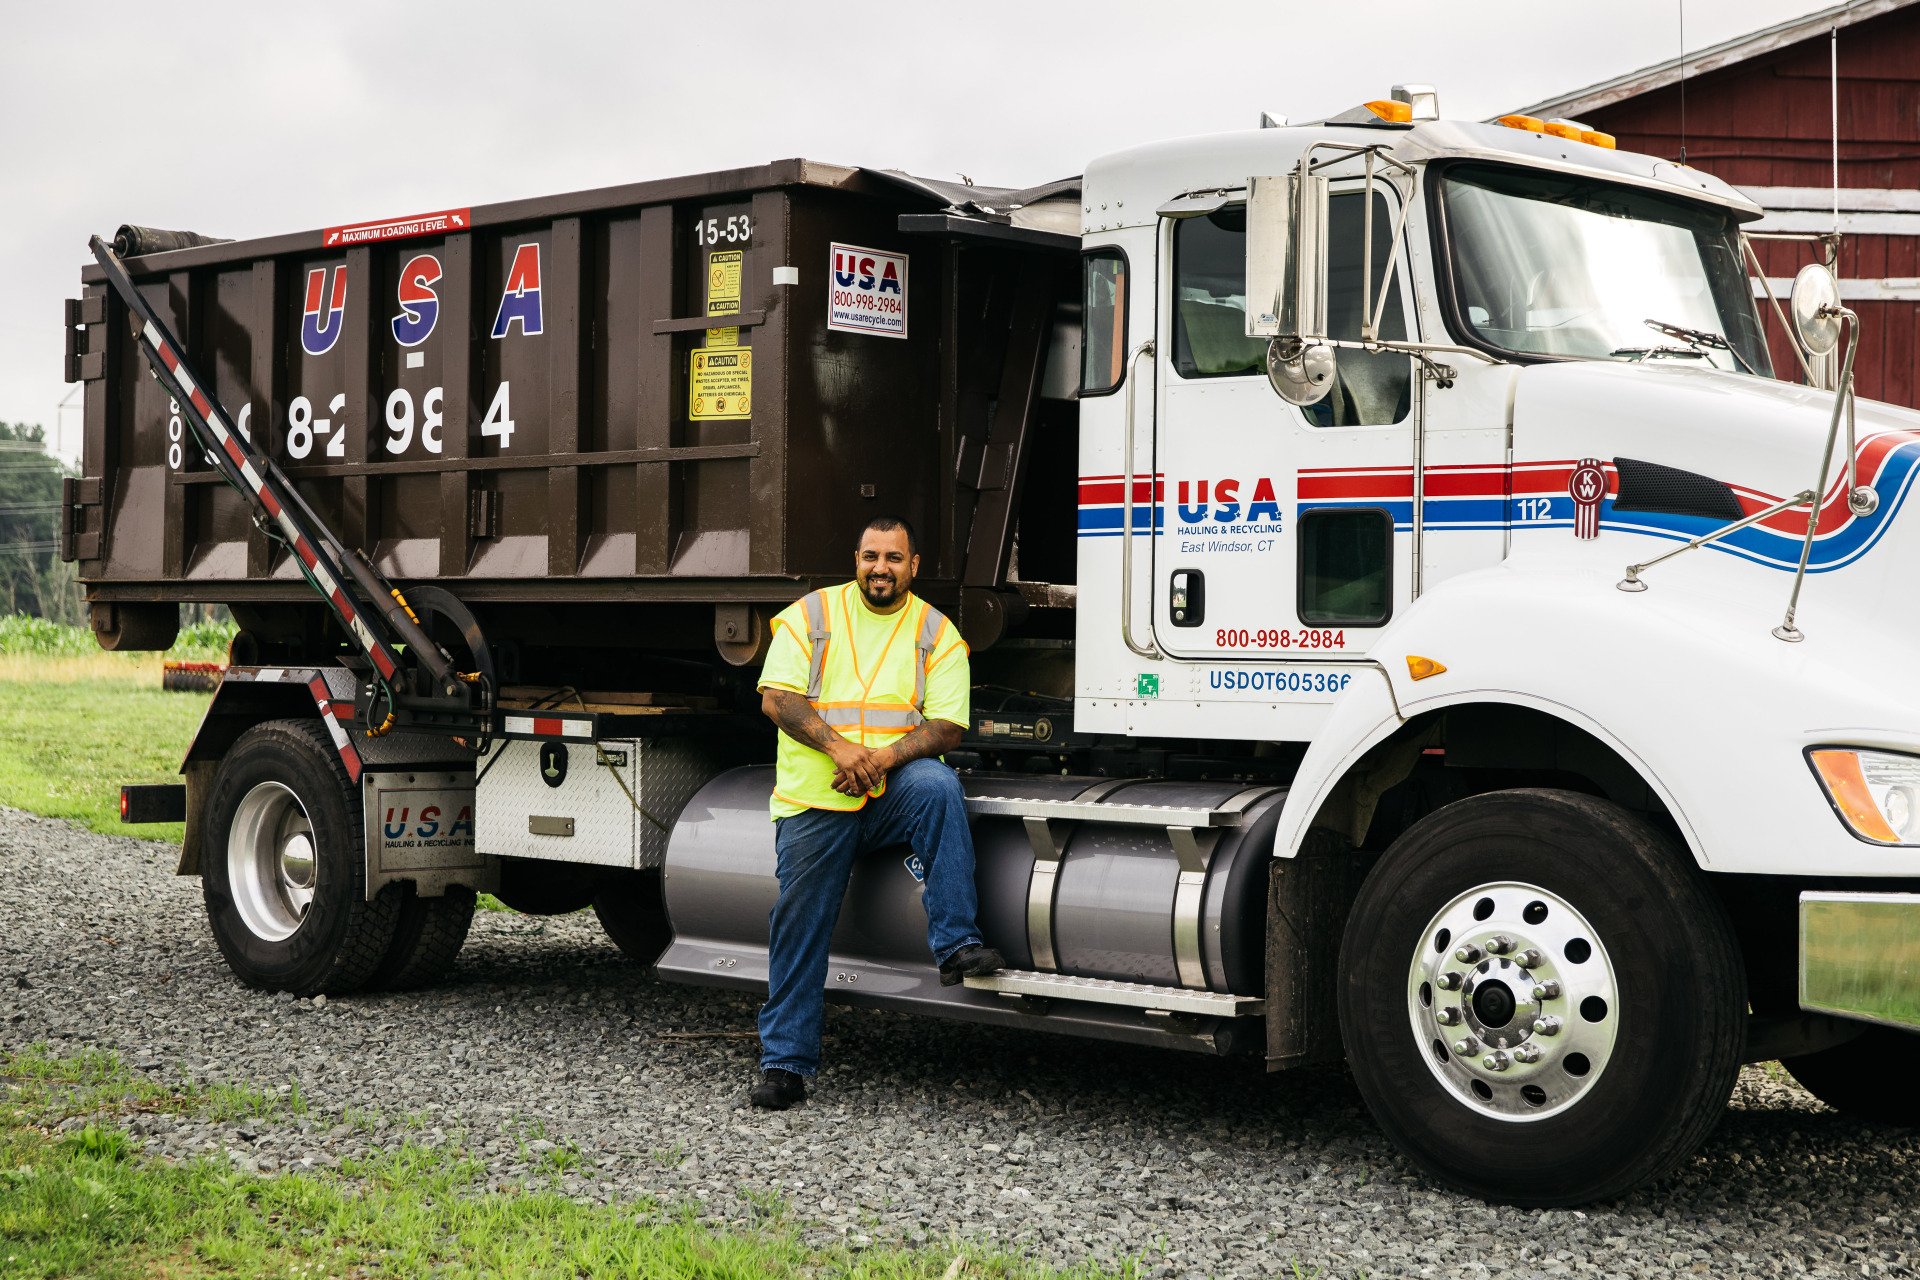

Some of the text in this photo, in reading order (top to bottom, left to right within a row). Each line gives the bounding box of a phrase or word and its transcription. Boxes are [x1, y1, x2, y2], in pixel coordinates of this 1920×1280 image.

[342, 219, 448, 243] MAXIMUM LOADING LEVEL
[695, 214, 753, 246] 15-53
[718, 253, 741, 262] CAUTION
[836, 253, 901, 294] USA
[716, 302, 738, 310] CAUTION
[834, 290, 902, 314] 800-998-2984
[834, 310, 902, 326] www.usarecycle.com
[714, 356, 737, 366] CAUTION
[1178, 478, 1282, 524] USA
[1517, 499, 1552, 520] 112
[1178, 524, 1282, 535] HAULING & RECYCLING
[1181, 540, 1275, 553] East Windsor, CT
[1216, 629, 1345, 649] 800-998-2984
[1210, 670, 1351, 693] USDOT605366
[385, 840, 415, 849] HAULING
[416, 840, 423, 848] &
[423, 839, 461, 848] RECYCLING
